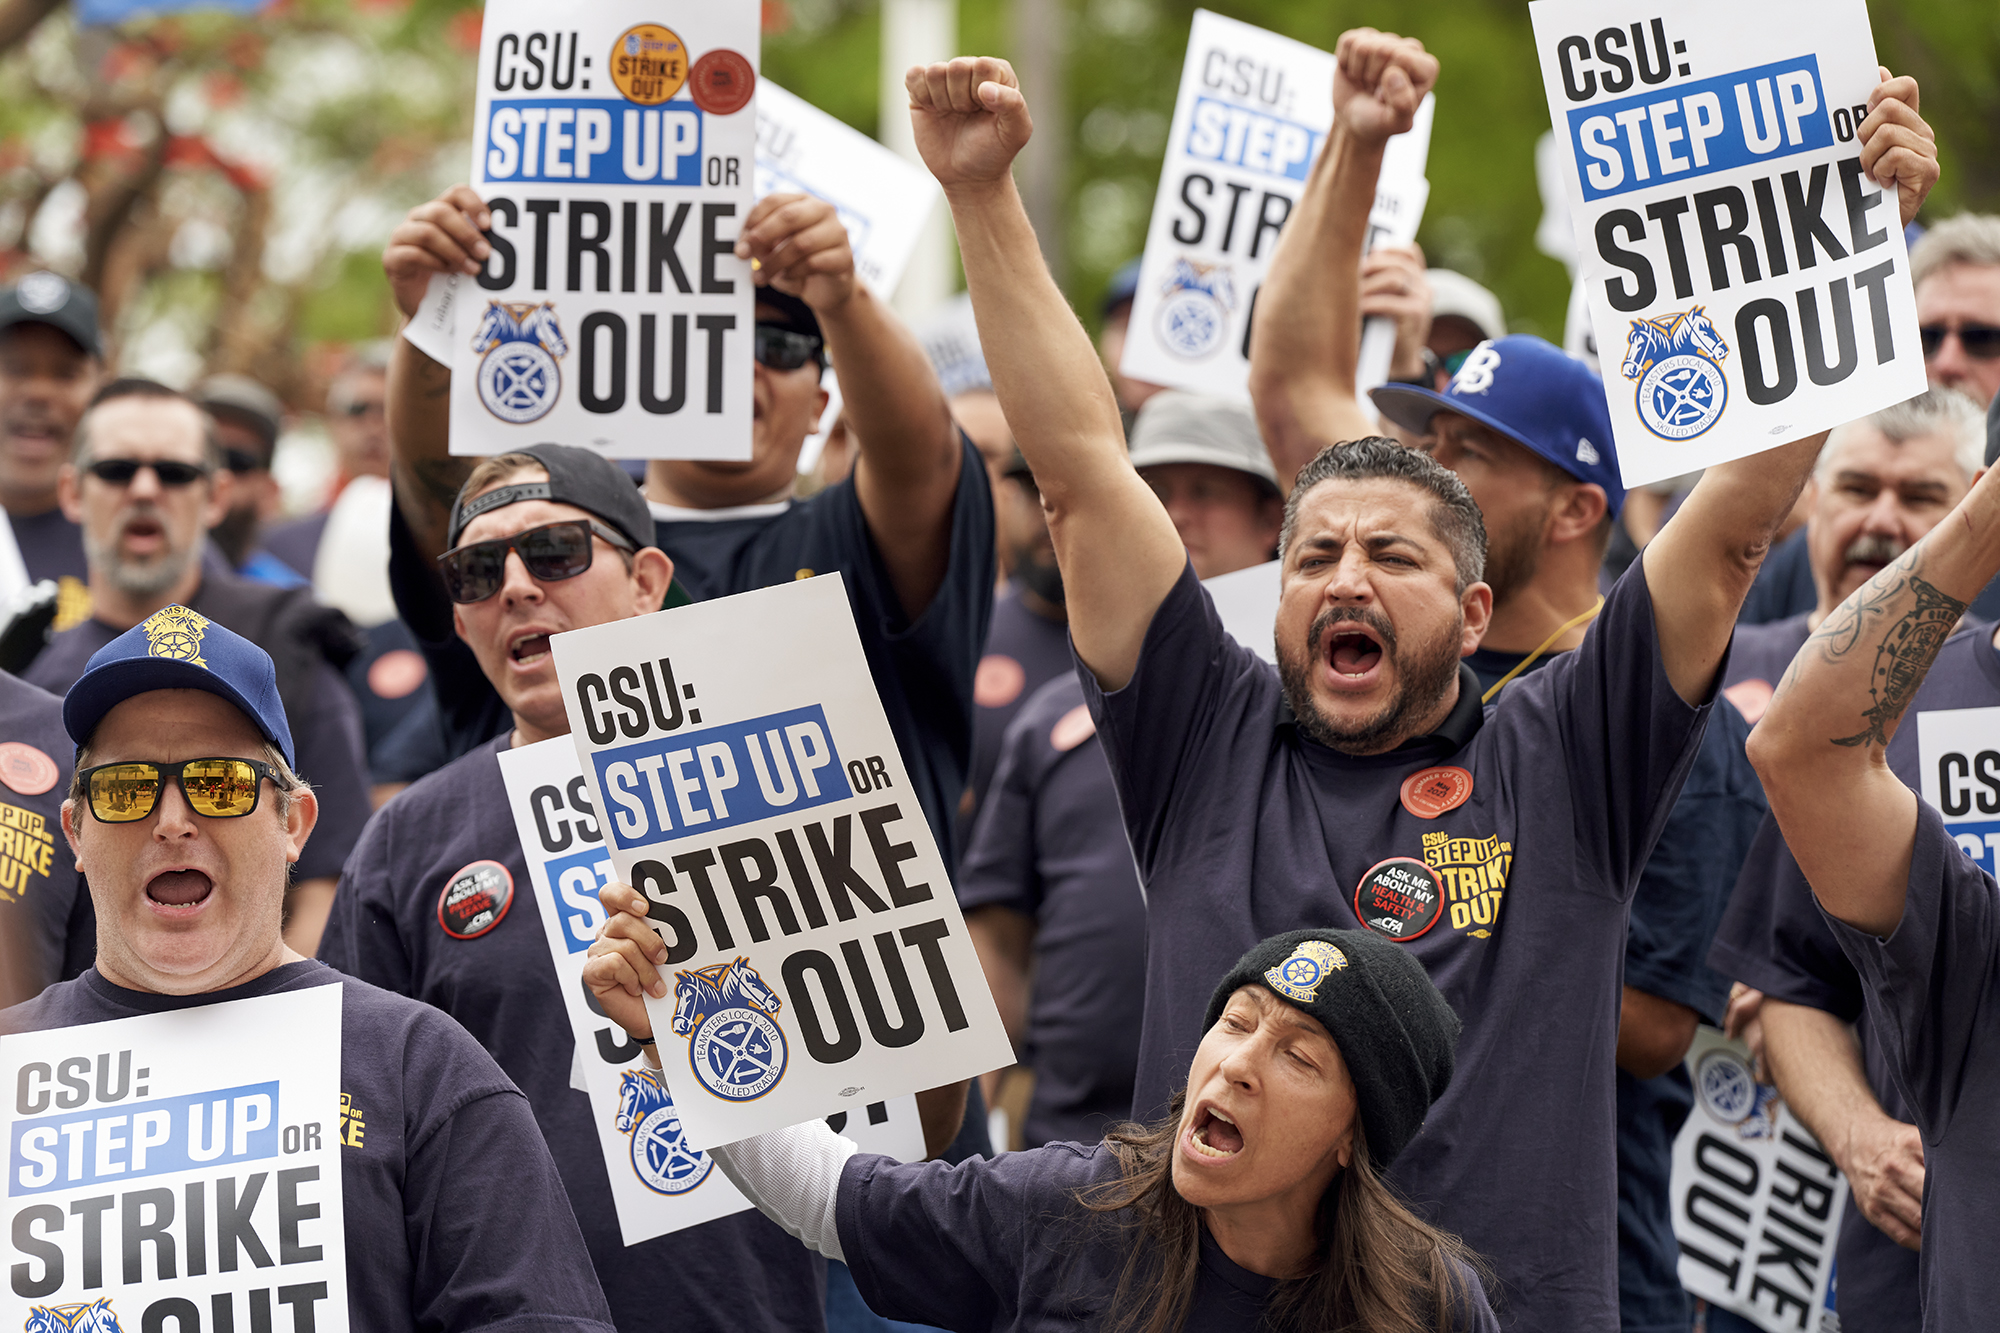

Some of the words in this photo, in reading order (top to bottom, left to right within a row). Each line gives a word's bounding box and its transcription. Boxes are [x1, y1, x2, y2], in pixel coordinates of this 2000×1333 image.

[494, 32, 592, 92] CSU:
[618, 56, 681, 80] STRIKE
[1202, 49, 1296, 112] CSU:
[1557, 17, 1691, 102] CSU:
[631, 78, 663, 99] OUT
[487, 107, 612, 179] STEP
[622, 109, 700, 181] UP
[707, 156, 741, 187] OR
[1189, 101, 1310, 175] STEP
[1579, 91, 1724, 190] STEP
[1733, 69, 1819, 155] UP
[476, 197, 737, 295] STRIKE
[1594, 157, 1888, 312] STRIKE
[1734, 258, 1896, 406] OUT
[578, 310, 737, 415] OUT
[1642, 359, 1676, 404] TEAMSTERS
[1677, 357, 1705, 370] LOCAL
[1705, 366, 1721, 387] 2010
[1654, 420, 1689, 436] SKILLED
[1689, 408, 1718, 434] TRADES
[576, 657, 703, 745] CSU:
[604, 740, 740, 840] STEP
[744, 720, 831, 807] UP
[847, 755, 893, 795] OR
[1426, 786, 1448, 799] 2023
[1421, 830, 1449, 847] CSU:
[1425, 840, 1471, 867] STEP
[1474, 837, 1497, 863] UP
[1500, 841, 1512, 852] OR
[446, 882, 482, 907] ABOUT
[482, 873, 501, 889] MY
[452, 876, 474, 893] ASK
[630, 802, 935, 965] STRIKE
[1370, 883, 1416, 909] HEALTH
[1415, 902, 1425, 914] &
[1373, 873, 1415, 896] ABOUT
[1413, 888, 1435, 904] MY
[1386, 866, 1412, 883] ASK
[1411, 875, 1431, 891] ME
[459, 898, 493, 920] LEAVE
[472, 909, 494, 927] CFA
[1372, 896, 1416, 920] SAFETY
[1381, 916, 1404, 934] CFA
[1450, 890, 1503, 930] OUT
[780, 917, 970, 1065] OUT
[1265, 970, 1288, 994] LOCAL
[1289, 988, 1311, 1000] 2010
[696, 1012, 728, 1063] TEAMSTERS
[728, 1010, 759, 1024] LOCAL
[759, 1019, 779, 1042] 2010
[15, 1049, 150, 1116] CSU:
[712, 1079, 751, 1097] SKILLED
[751, 1065, 779, 1093] TRADES
[350, 1108, 363, 1120] OR
[636, 1111, 666, 1158] TEAMSTERS
[18, 1108, 172, 1190] STEP
[187, 1092, 272, 1163] UP
[282, 1121, 322, 1156] OR
[648, 1173, 681, 1191] SKILLED
[683, 1160, 709, 1189] TRADES
[10, 1164, 324, 1300] STRIKE
[1676, 1131, 1760, 1293] OUT
